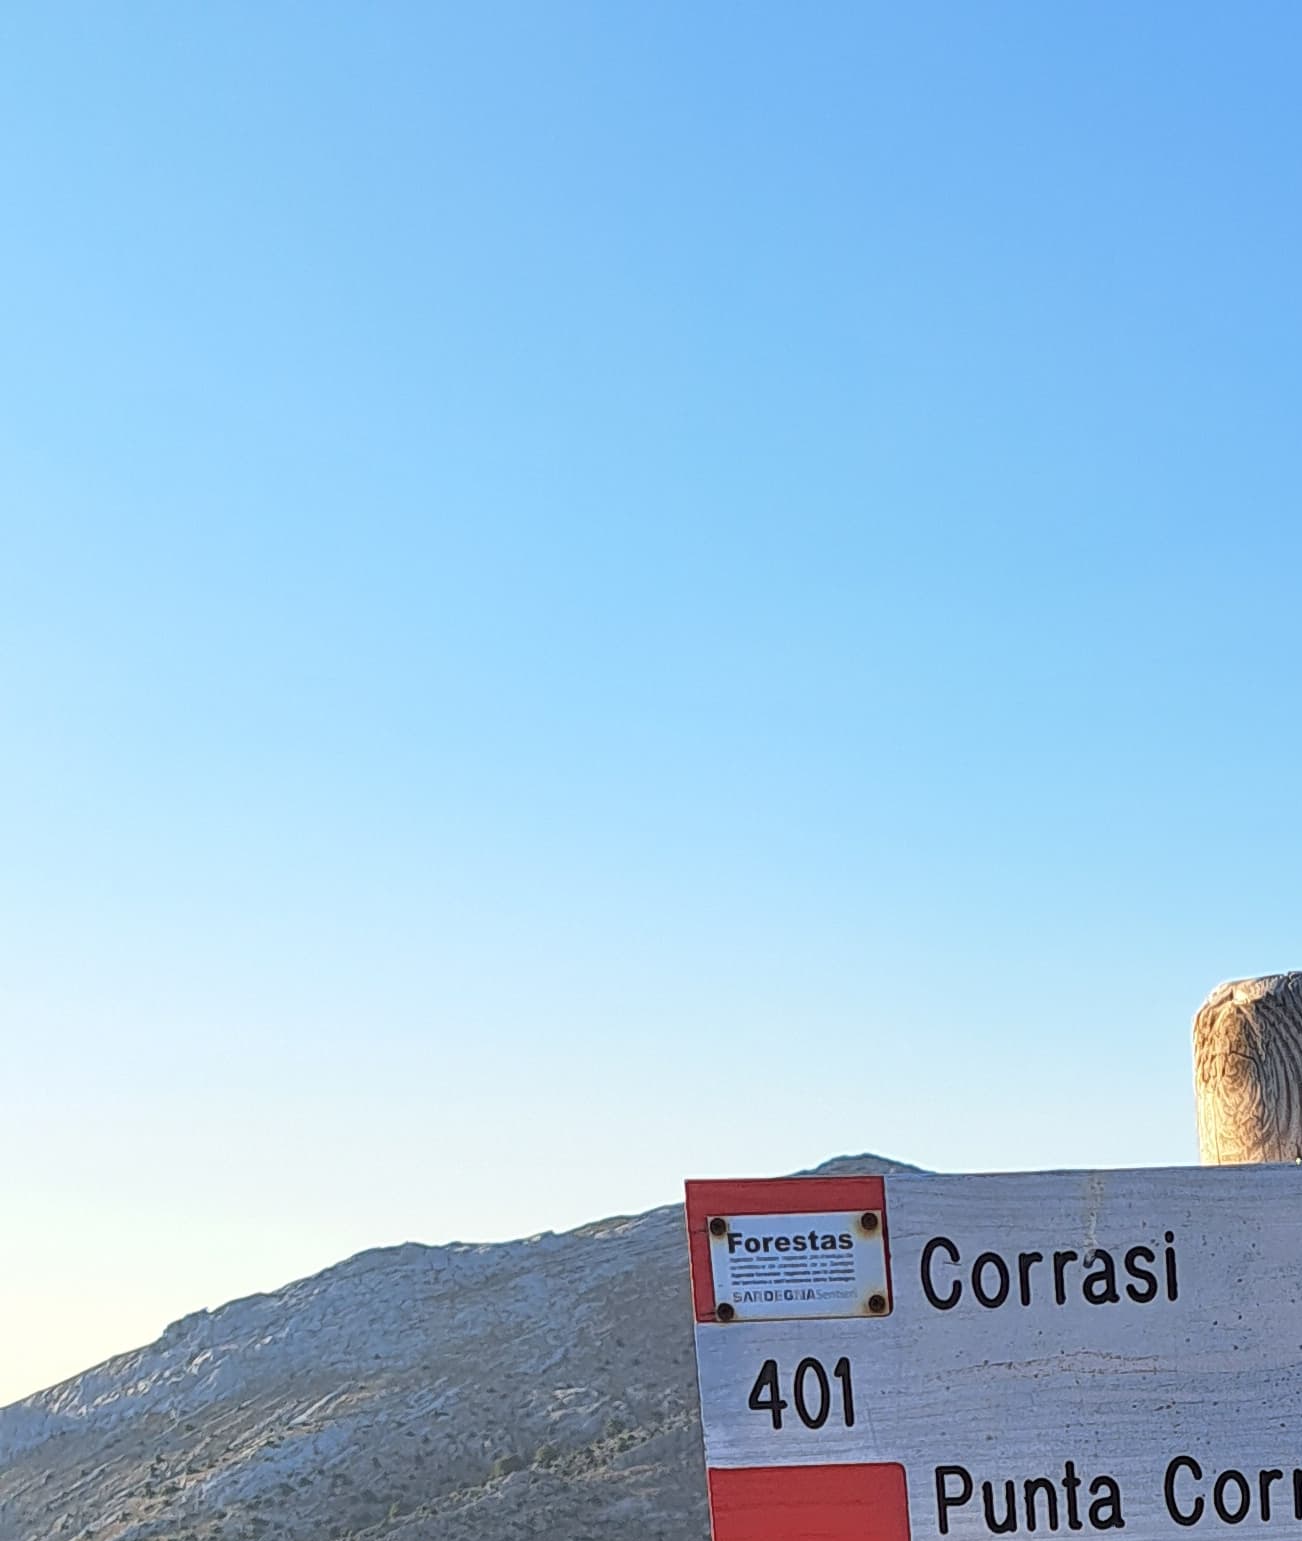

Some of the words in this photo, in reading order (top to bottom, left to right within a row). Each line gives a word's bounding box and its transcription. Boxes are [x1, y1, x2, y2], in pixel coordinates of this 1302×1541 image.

[726, 1231, 854, 1255] Forestas
[921, 1231, 1178, 1310] Corrasi
[748, 1356, 855, 1430] 401
[935, 1460, 1125, 1535] Punta
